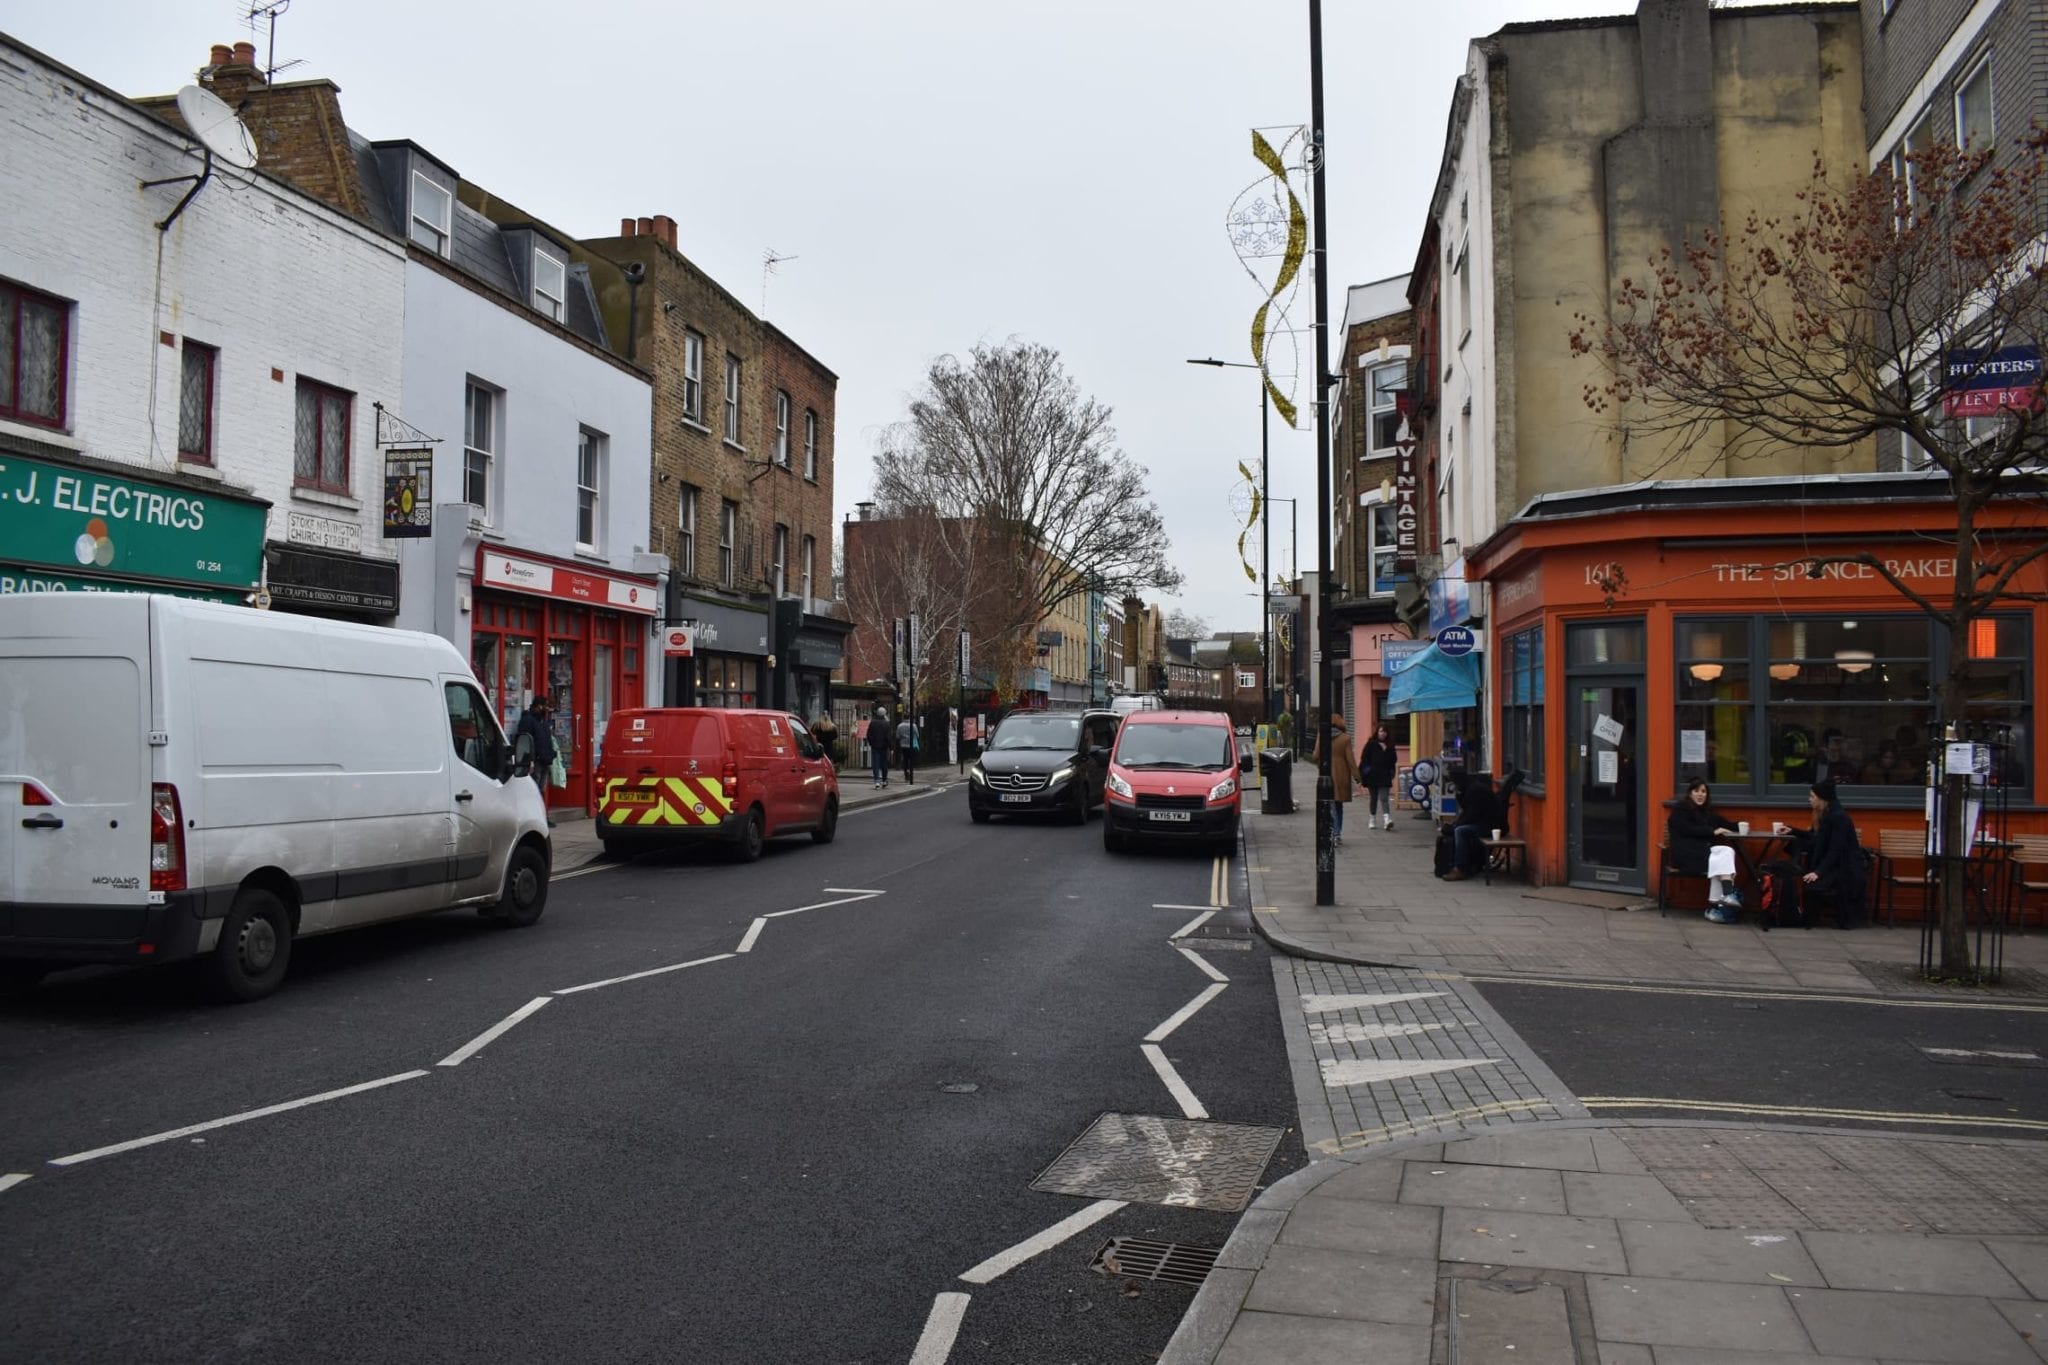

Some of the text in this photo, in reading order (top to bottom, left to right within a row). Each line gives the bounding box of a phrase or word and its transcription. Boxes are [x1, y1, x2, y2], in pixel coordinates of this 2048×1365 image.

[1965, 391, 2018, 406] LET BY
[53, 476, 205, 531] ELECTRICS
[1397, 445, 1417, 546] VINTAGE
[1712, 562, 1763, 582] THE
[1885, 557, 1984, 578] BAKE
[1444, 631, 1467, 641] ATM
[92, 876, 140, 885] MOVANO
